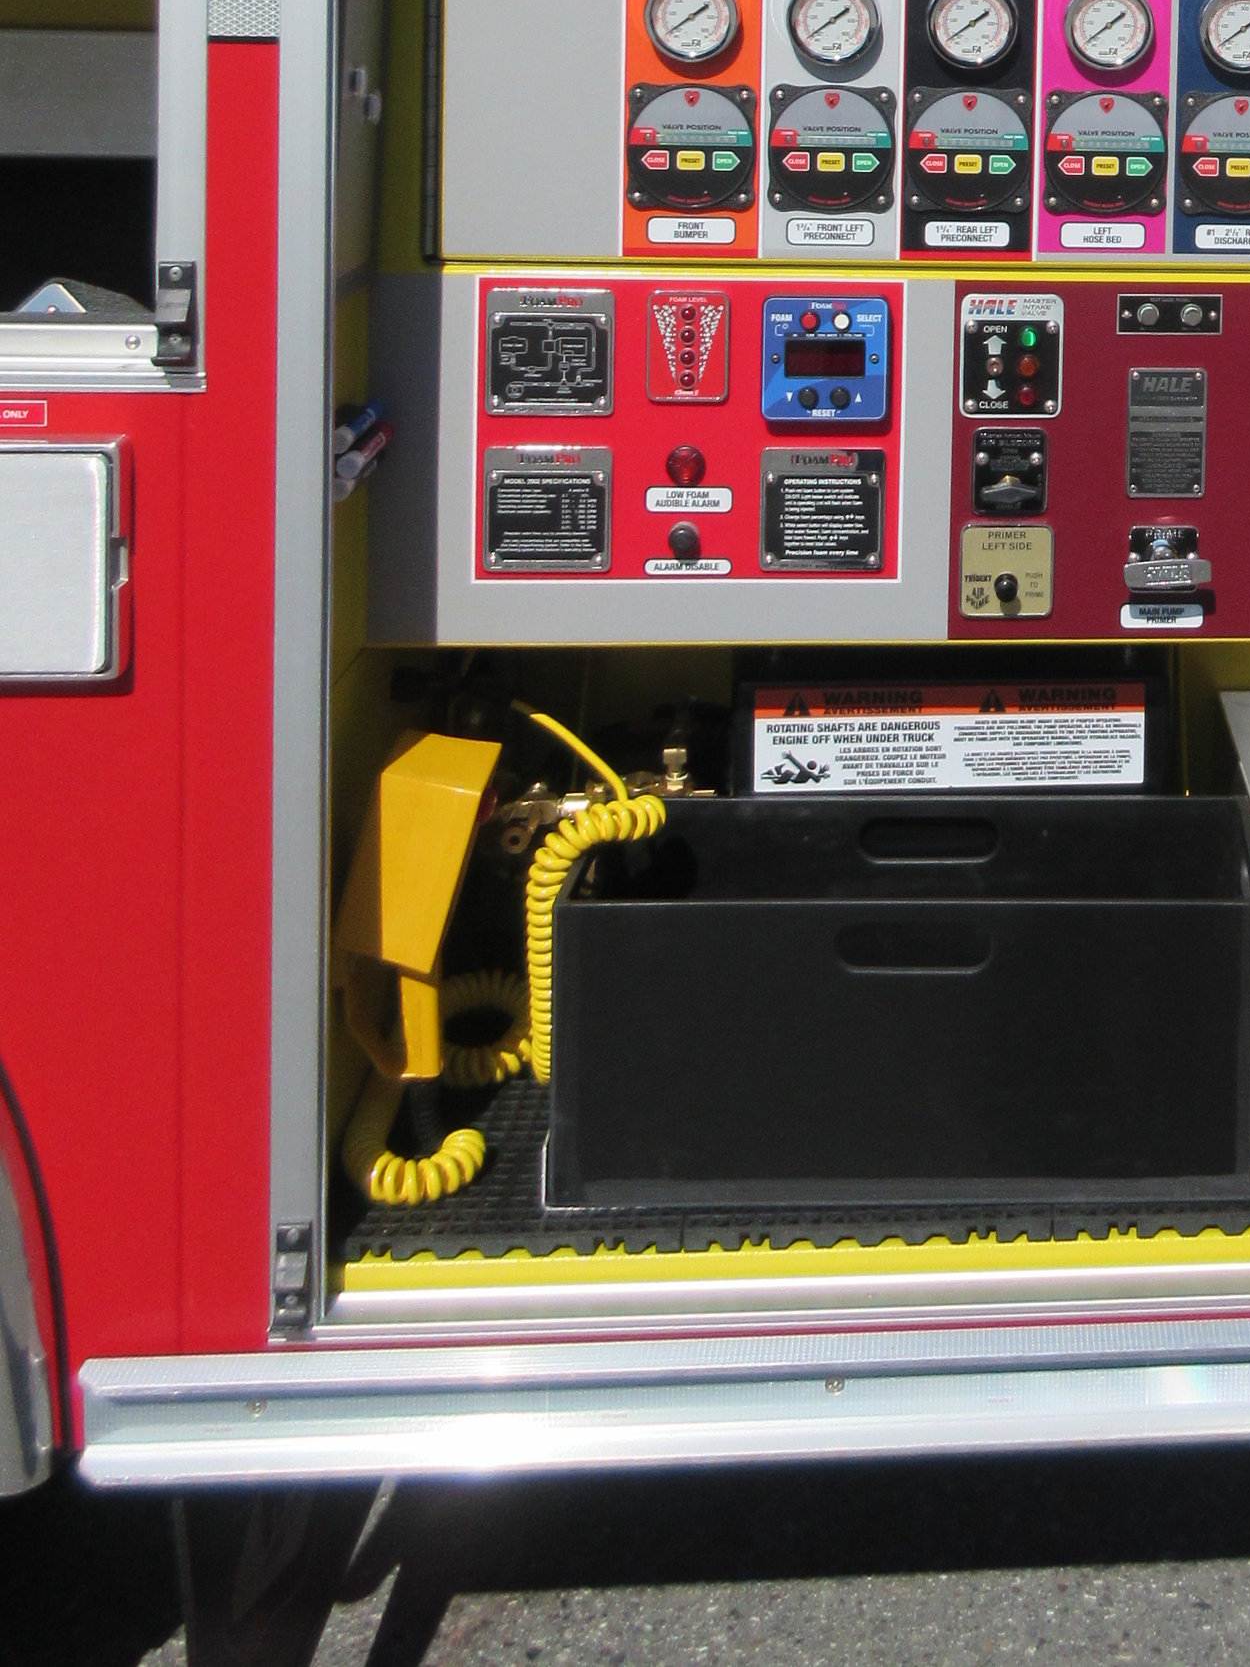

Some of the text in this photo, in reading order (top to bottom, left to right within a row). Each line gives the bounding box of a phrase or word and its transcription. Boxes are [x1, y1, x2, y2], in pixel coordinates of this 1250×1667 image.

[678, 222, 705, 230] FRONT
[816, 224, 843, 232] FRONT
[845, 224, 864, 233] LEFT
[956, 226, 977, 234] REAR
[980, 226, 998, 234] LEFT
[674, 230, 708, 239] BUMPER
[1093, 227, 1112, 235] LEFT
[803, 232, 856, 241] PRECONNECT
[940, 234, 993, 243] PRECONNECT
[1083, 235, 1122, 244] HOSE BED
[968, 299, 1017, 315] HALE
[771, 314, 882, 322] FOAM SELECT
[983, 325, 1008, 333] OPEN
[1142, 376, 1193, 392] HALE
[979, 401, 1008, 409] CLOSE
[3, 410, 28, 419] ONLY
[812, 409, 836, 417] RESET
[666, 491, 709, 499] LOW FOAM
[655, 499, 690, 507] AUDIBLE
[988, 531, 1026, 539] PRIMER
[982, 542, 1032, 550] LEFT SIDE
[654, 563, 719, 571] ALARM DISABLE
[1139, 607, 1160, 615] MAIN
[1146, 616, 1177, 624] PRIMER
[824, 691, 923, 706] WARNING
[766, 721, 941, 733] ROTATING SHAFTS ARE DANGEROUS
[772, 733, 935, 745] ENGINE OFF WHEN UNDER TRUCK
